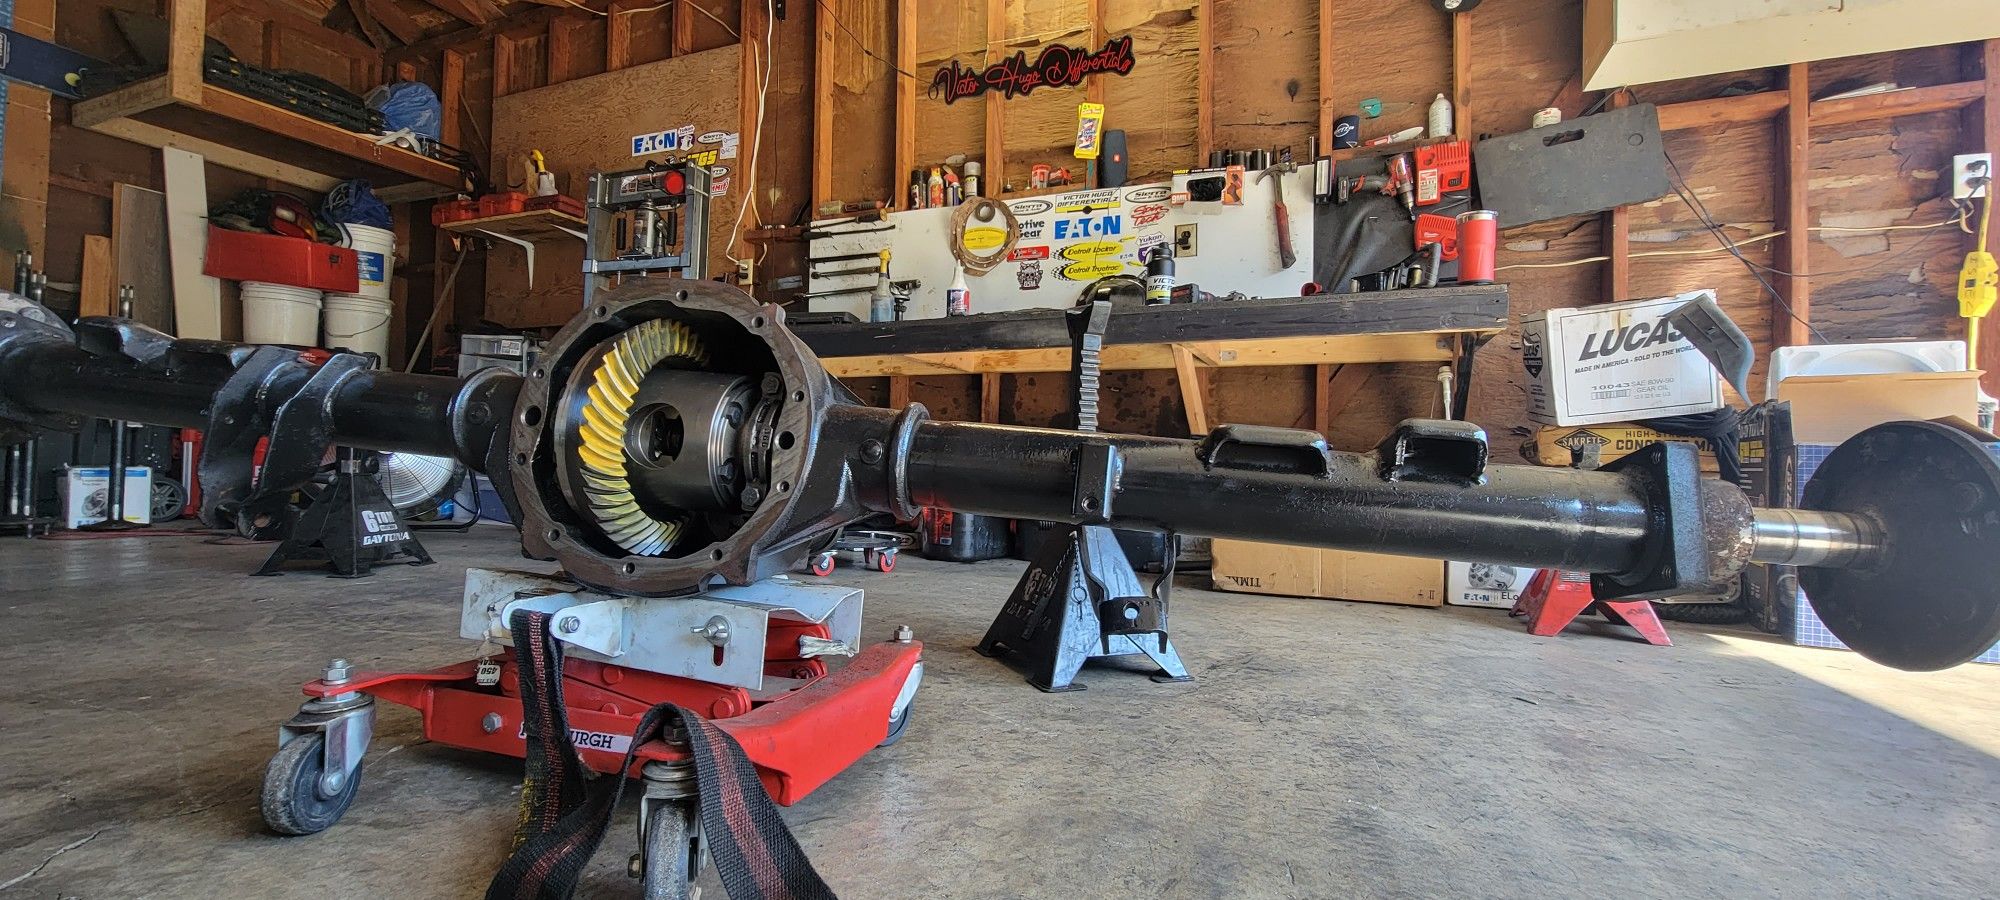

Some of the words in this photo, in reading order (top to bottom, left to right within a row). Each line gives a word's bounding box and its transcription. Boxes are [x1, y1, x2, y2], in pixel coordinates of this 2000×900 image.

[937, 62, 980, 101] Victor
[984, 54, 1043, 97] Hugo
[1039, 39, 1131, 84] Differentials
[633, 132, 676, 154] EATON
[1057, 196, 1119, 207] DIFFERENTIALZ
[1018, 219, 1045, 229] otive
[1054, 215, 1121, 240] EATON
[1067, 247, 1091, 256] Detroit
[1067, 266, 1091, 274] Detroit
[1092, 264, 1120, 273] Truetrac
[1153, 277, 1176, 285] VICTO
[1574, 365, 1593, 374] MADE
[1593, 363, 1601, 371] IN
[1601, 358, 1629, 369] AMERICA
[1633, 353, 1651, 362] SOLD
[1662, 349, 1674, 357] THE
[1591, 382, 1630, 391] 10043
[361, 510, 380, 533] 6
[374, 511, 396, 524] TON
[362, 531, 411, 546] DAYTONA
[1225, 575, 1262, 587] TIMK
[1501, 591, 1520, 601] ELo
